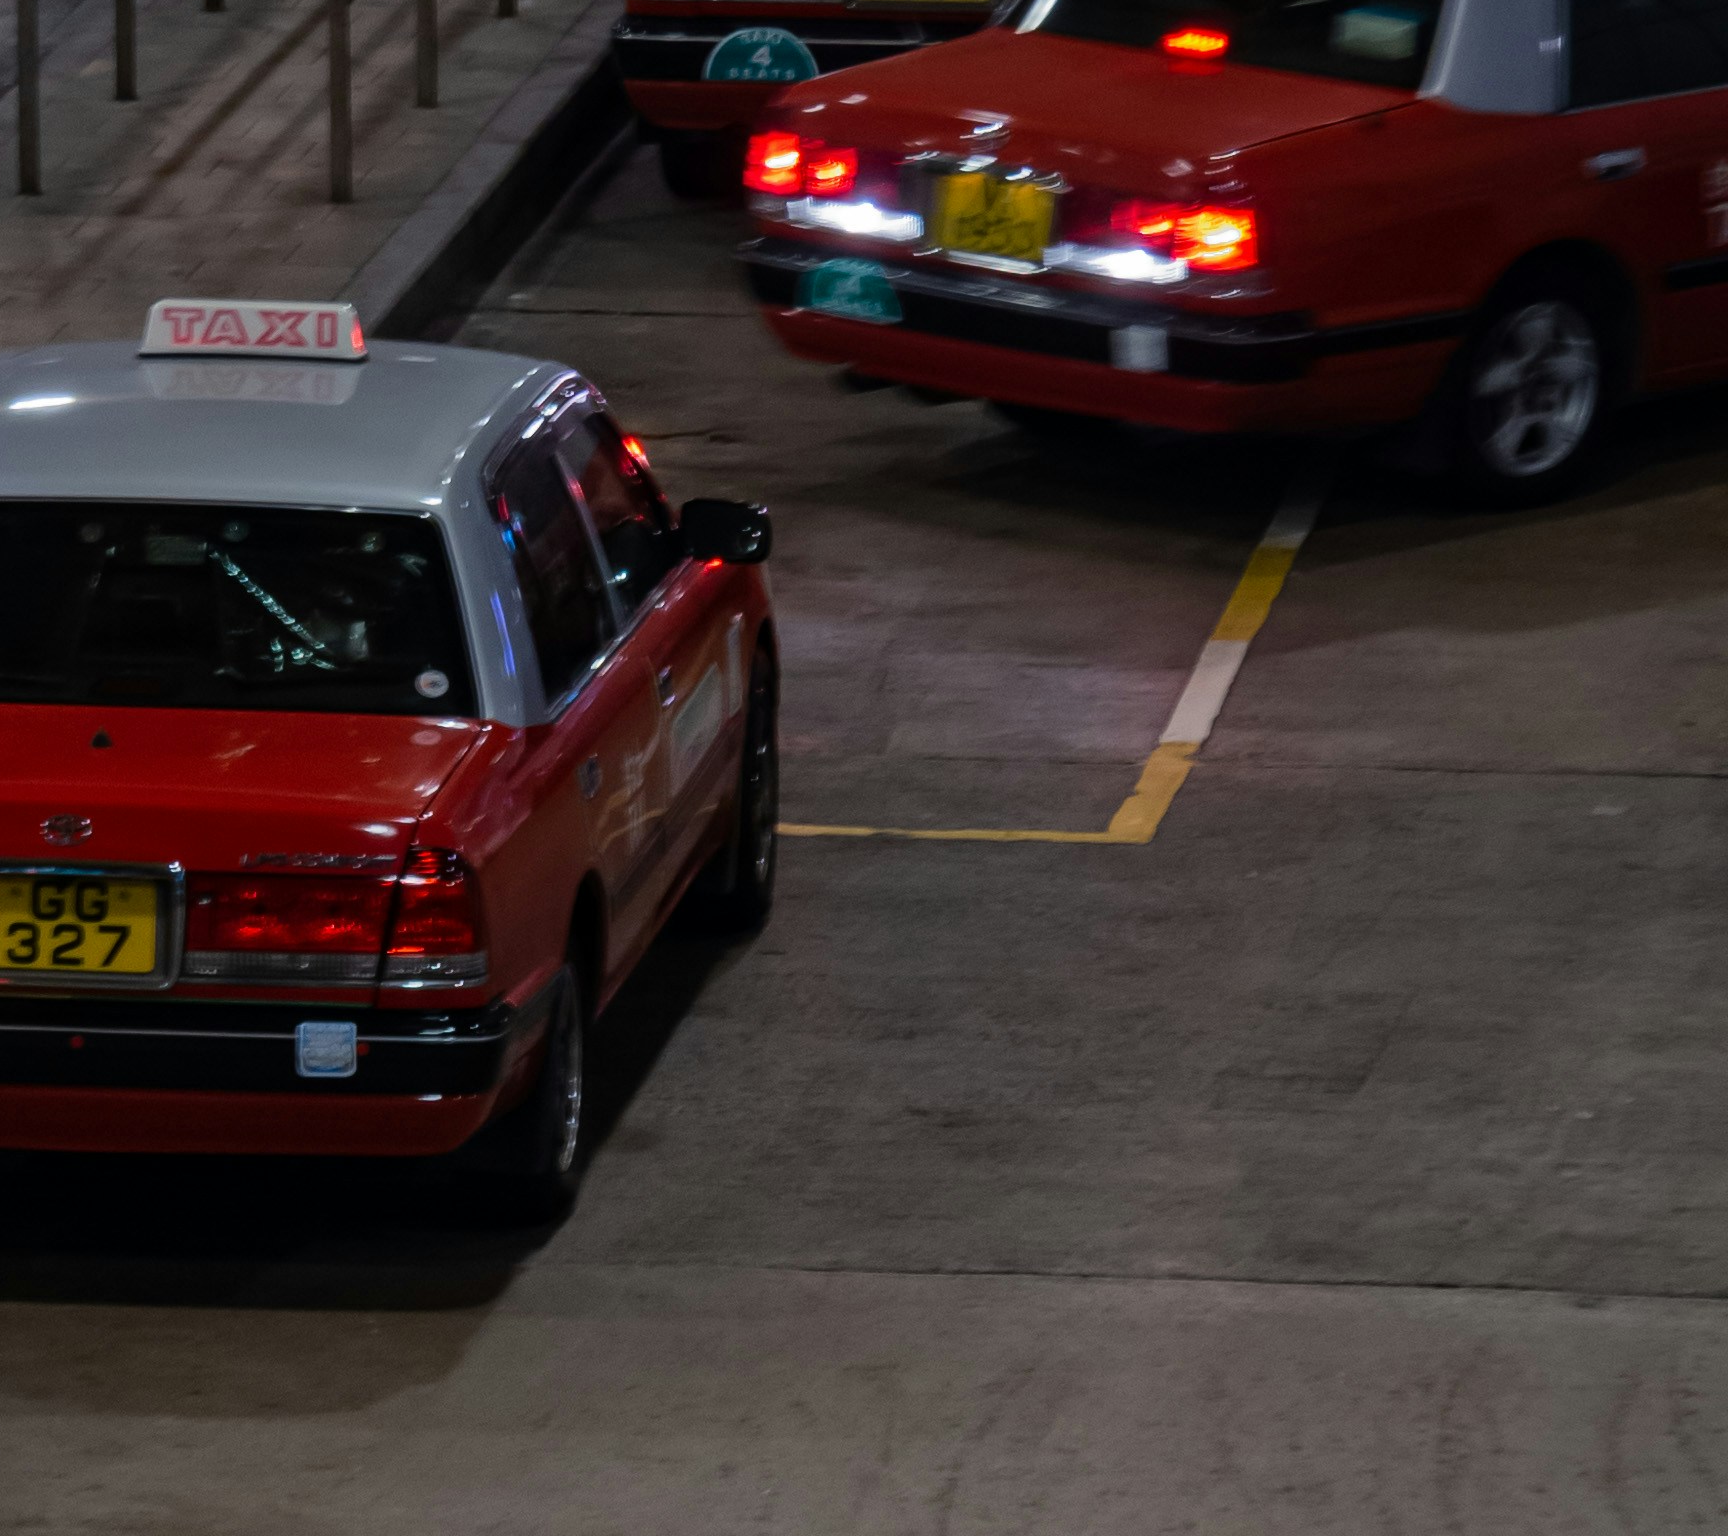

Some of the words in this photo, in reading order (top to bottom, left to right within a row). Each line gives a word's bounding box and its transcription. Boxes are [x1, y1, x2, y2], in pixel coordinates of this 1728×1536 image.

[750, 46, 772, 67] 4
[162, 308, 339, 348] TAXI
[32, 879, 108, 922] GG
[6, 922, 131, 966] 327
